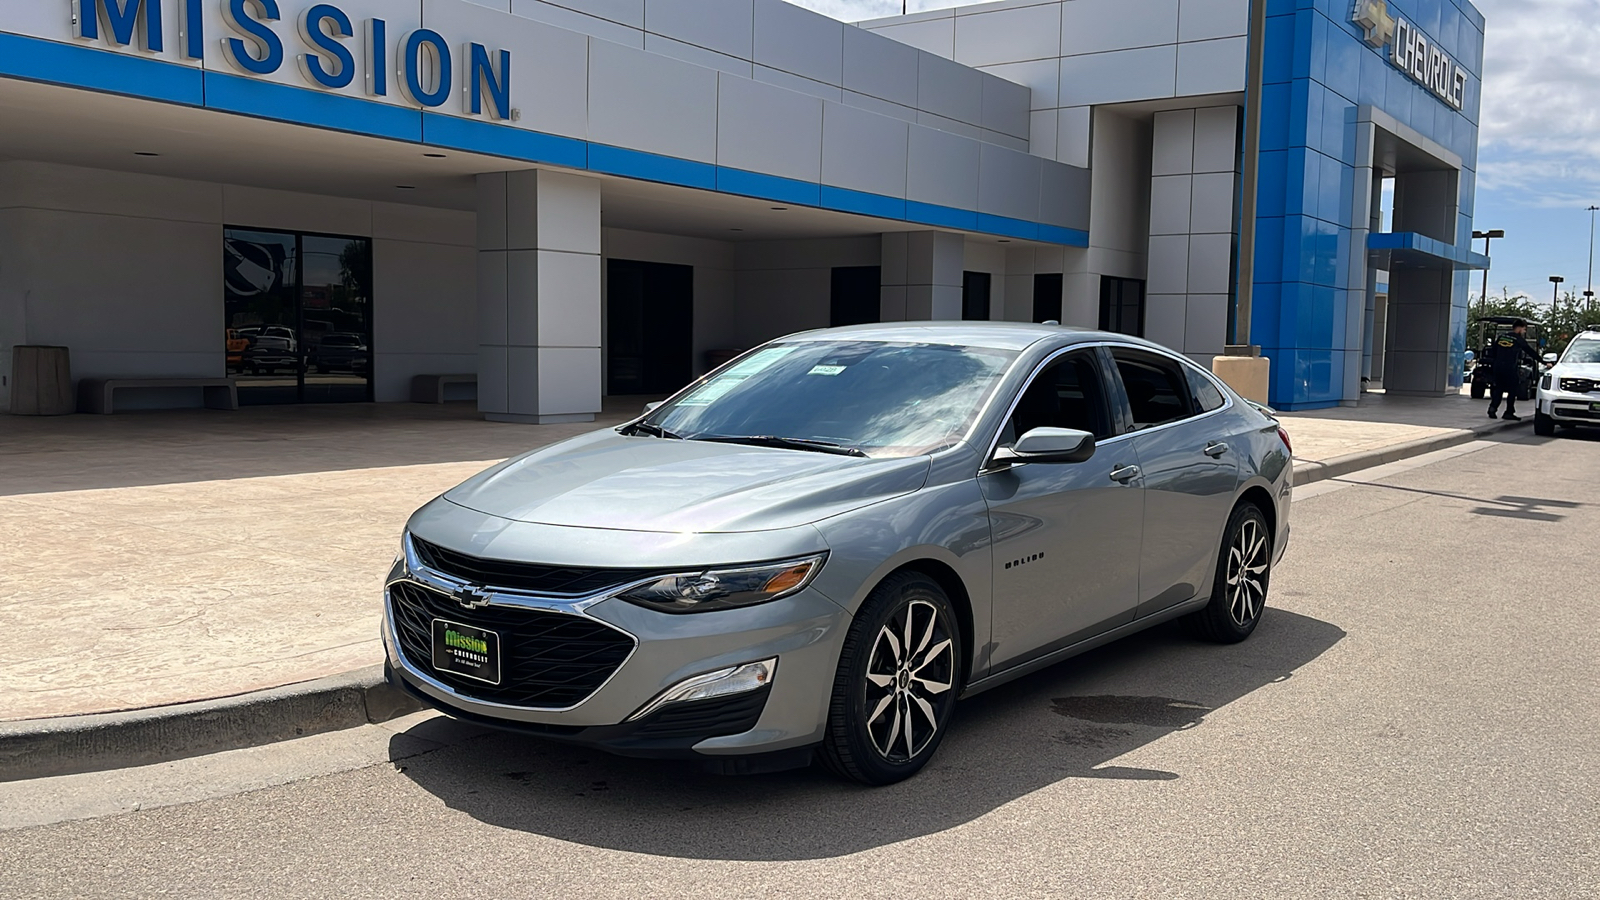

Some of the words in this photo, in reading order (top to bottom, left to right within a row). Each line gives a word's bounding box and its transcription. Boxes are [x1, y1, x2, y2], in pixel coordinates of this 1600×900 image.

[73, 0, 511, 121] MISSION
[1395, 17, 1468, 110] CHEVROLET
[1005, 552, 1044, 569] MALIBU
[445, 629, 487, 654] Mission
